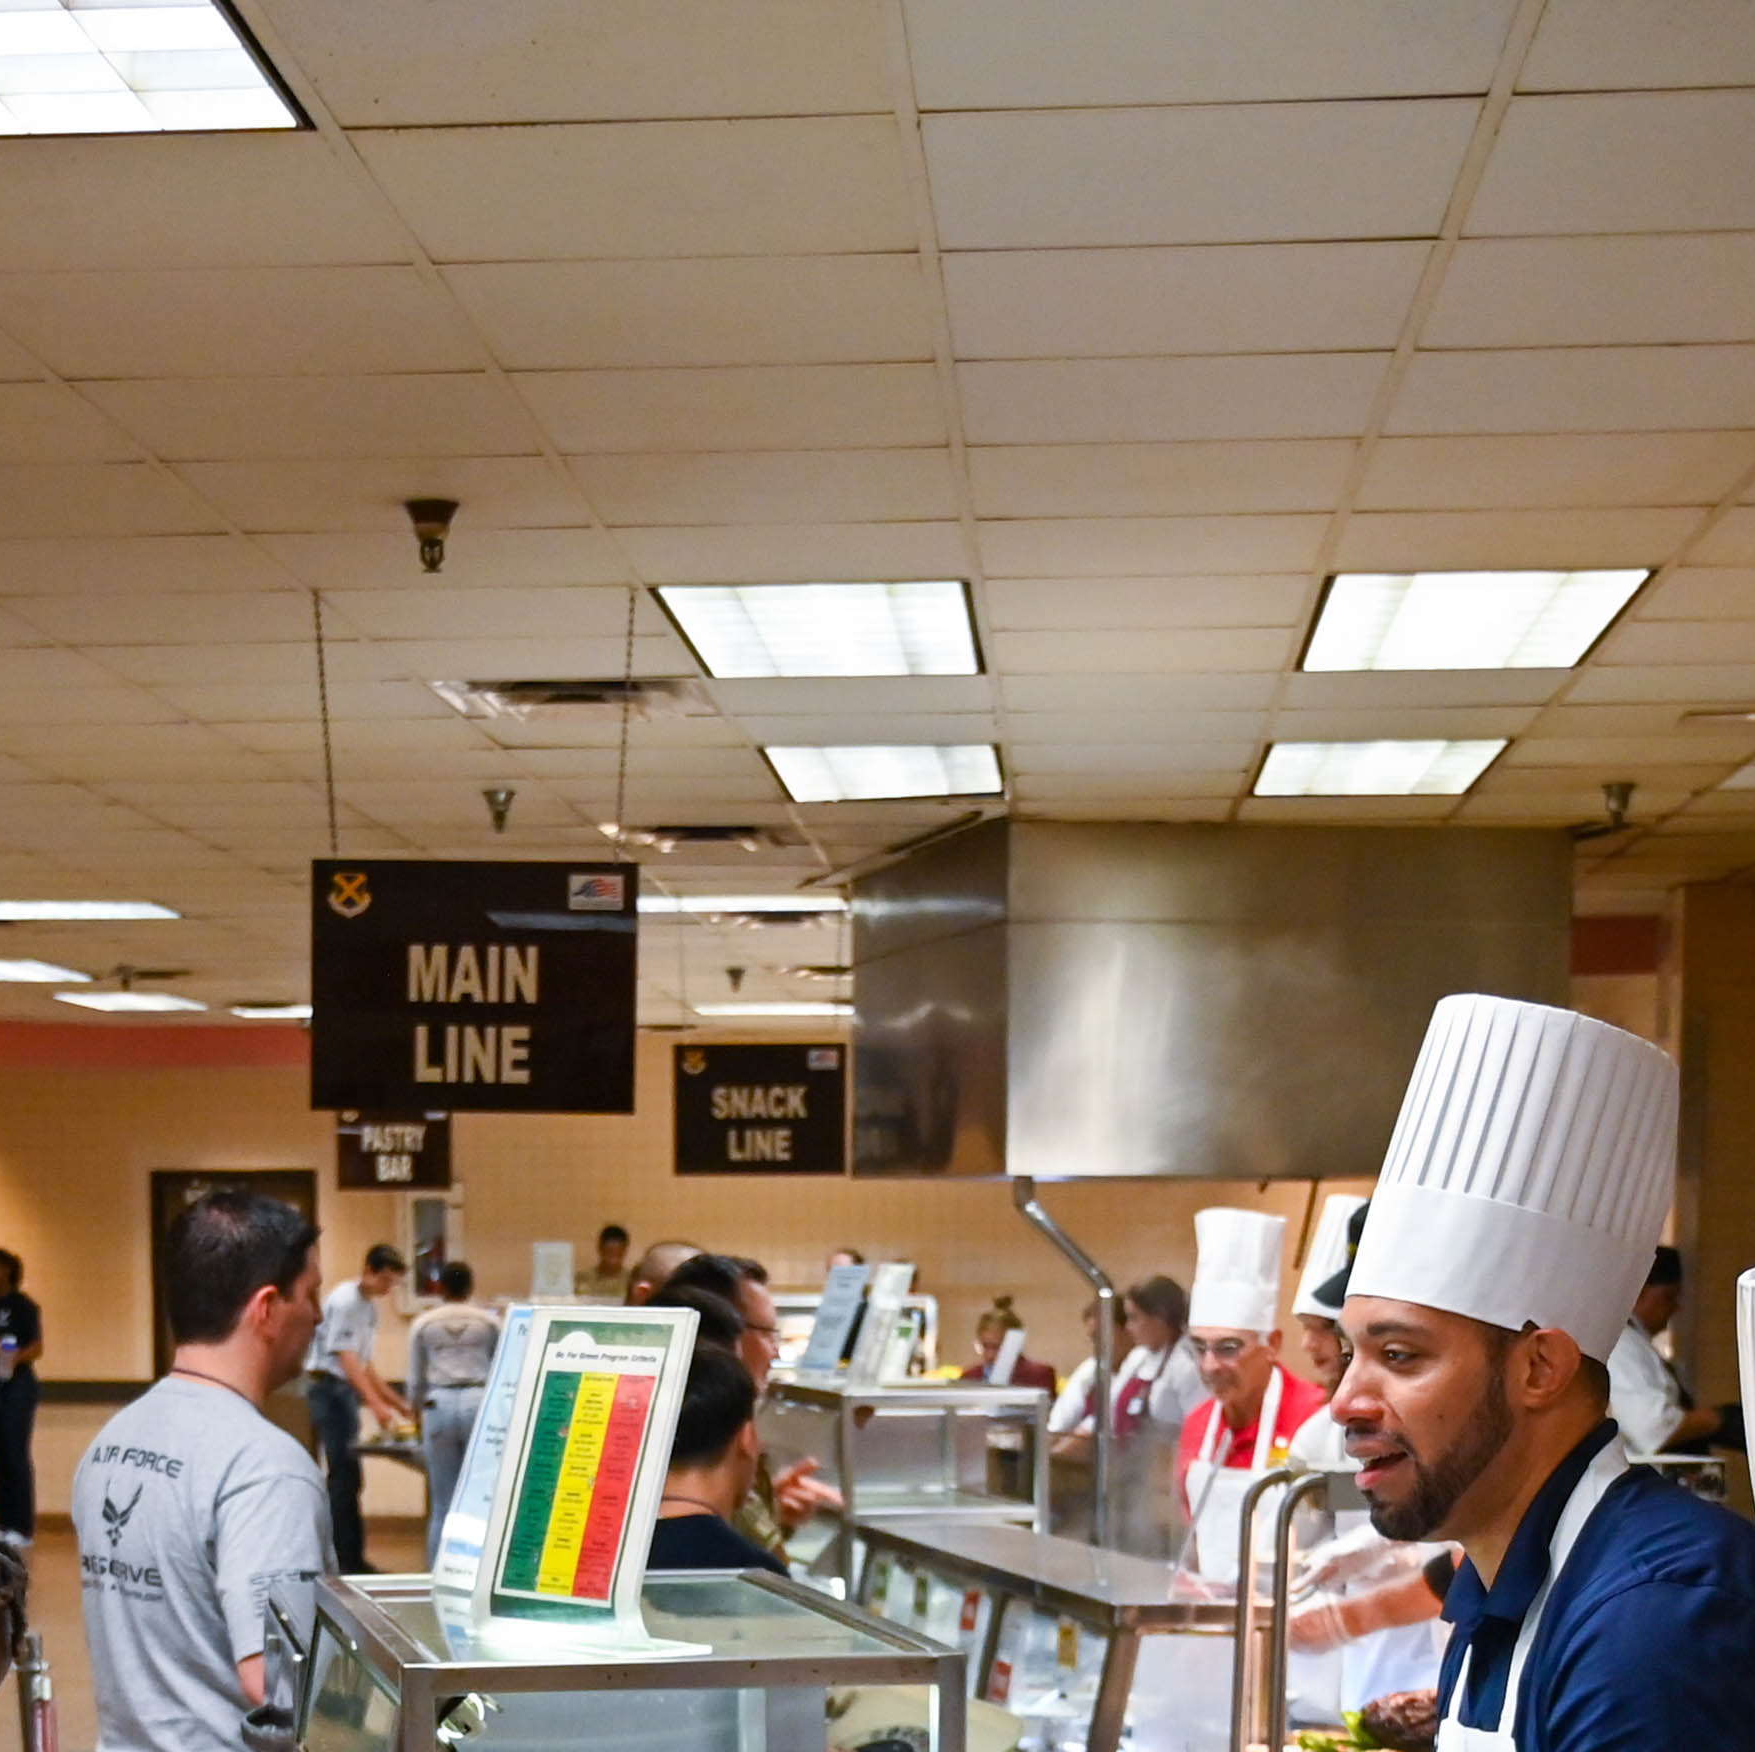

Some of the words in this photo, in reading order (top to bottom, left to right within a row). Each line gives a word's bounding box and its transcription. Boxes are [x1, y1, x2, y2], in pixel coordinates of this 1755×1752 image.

[408, 944, 539, 1004] MAIN
[415, 1025, 531, 1084] LINE
[710, 1085, 808, 1119] SNACK
[361, 1124, 426, 1152] PASTRY
[727, 1128, 792, 1161] LINE
[376, 1155, 413, 1182] BAR
[601, 1353, 629, 1362] Program
[631, 1355, 657, 1363] Criteria
[92, 1445, 120, 1465] AIR
[121, 1447, 184, 1480] FORCE
